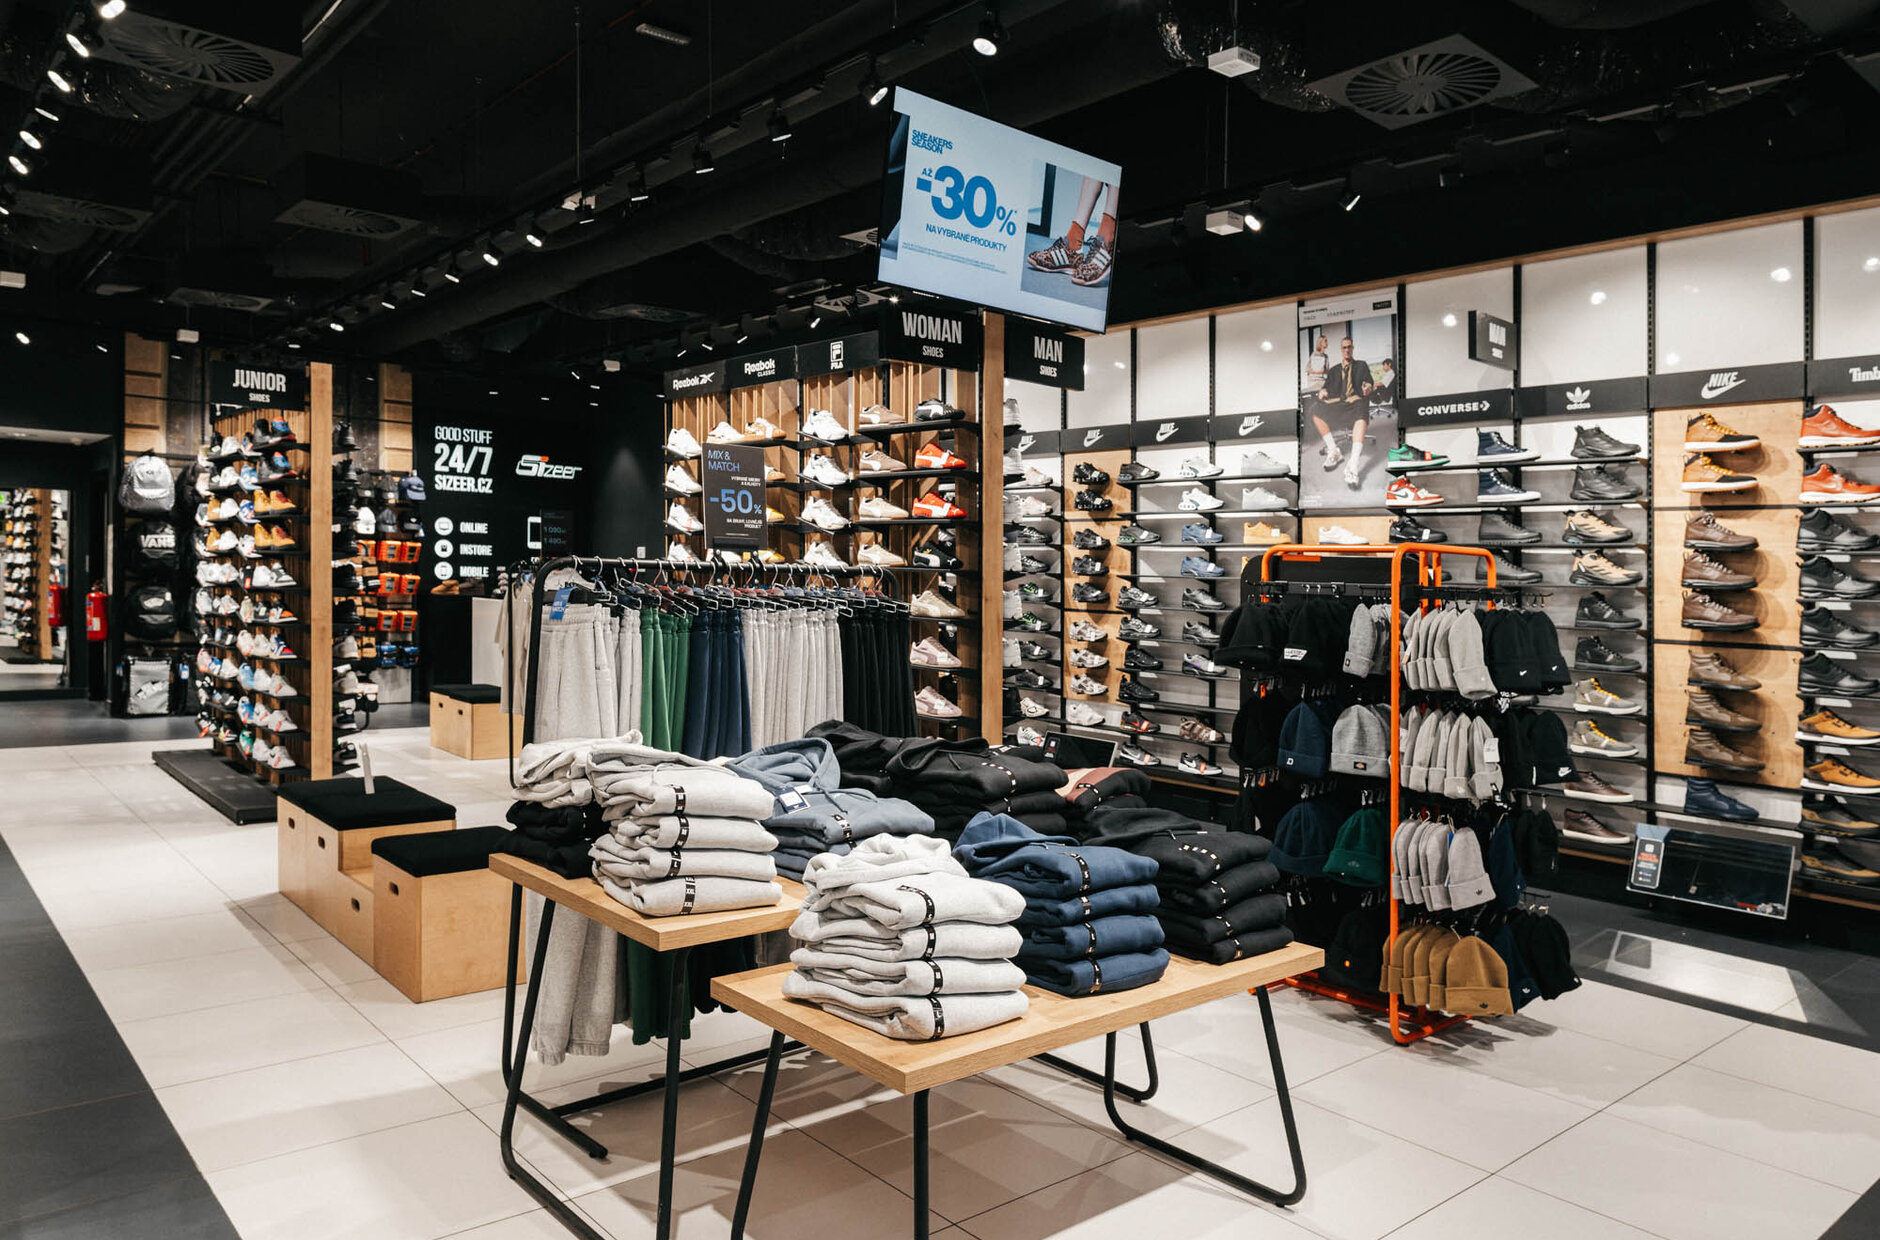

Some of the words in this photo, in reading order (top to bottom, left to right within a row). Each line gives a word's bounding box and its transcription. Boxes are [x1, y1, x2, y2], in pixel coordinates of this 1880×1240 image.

[912, 130, 954, 150] SNEAKERS
[912, 139, 943, 154] SEASON
[922, 168, 933, 178] AŽ
[926, 224, 936, 234] NA
[970, 236, 1008, 252] PRODUKTY
[902, 312, 962, 344] WOMAN
[922, 345, 944, 358] SHOES
[1034, 336, 1062, 364] MAN
[744, 358, 776, 375] Reebok
[830, 362, 844, 370] FILA
[1040, 365, 1058, 378] SHOES
[232, 368, 286, 392] JUNIOR
[758, 370, 776, 378] CLASSIC
[1708, 372, 1738, 388] NIKE
[672, 376, 700, 390] Reebok
[1418, 401, 1479, 416] CONVERSE
[1566, 402, 1591, 411] adidas
[1160, 422, 1176, 434] NIKE
[1243, 416, 1260, 426] NIKE
[434, 426, 462, 442] GOOD
[462, 428, 494, 444] STUFF
[1087, 430, 1100, 439] NIKE
[434, 442, 494, 476] 24/7
[708, 450, 724, 460] MIX
[724, 452, 730, 460] &
[516, 454, 583, 480] Sizeer
[708, 460, 740, 472] MATCH
[434, 474, 494, 494] SIZEER.CZ
[710, 488, 762, 514] -50%
[460, 522, 488, 534] ONLINE
[140, 534, 176, 548] VANS
[460, 544, 492, 556] INSTORE
[460, 566, 490, 578] MOBILE
